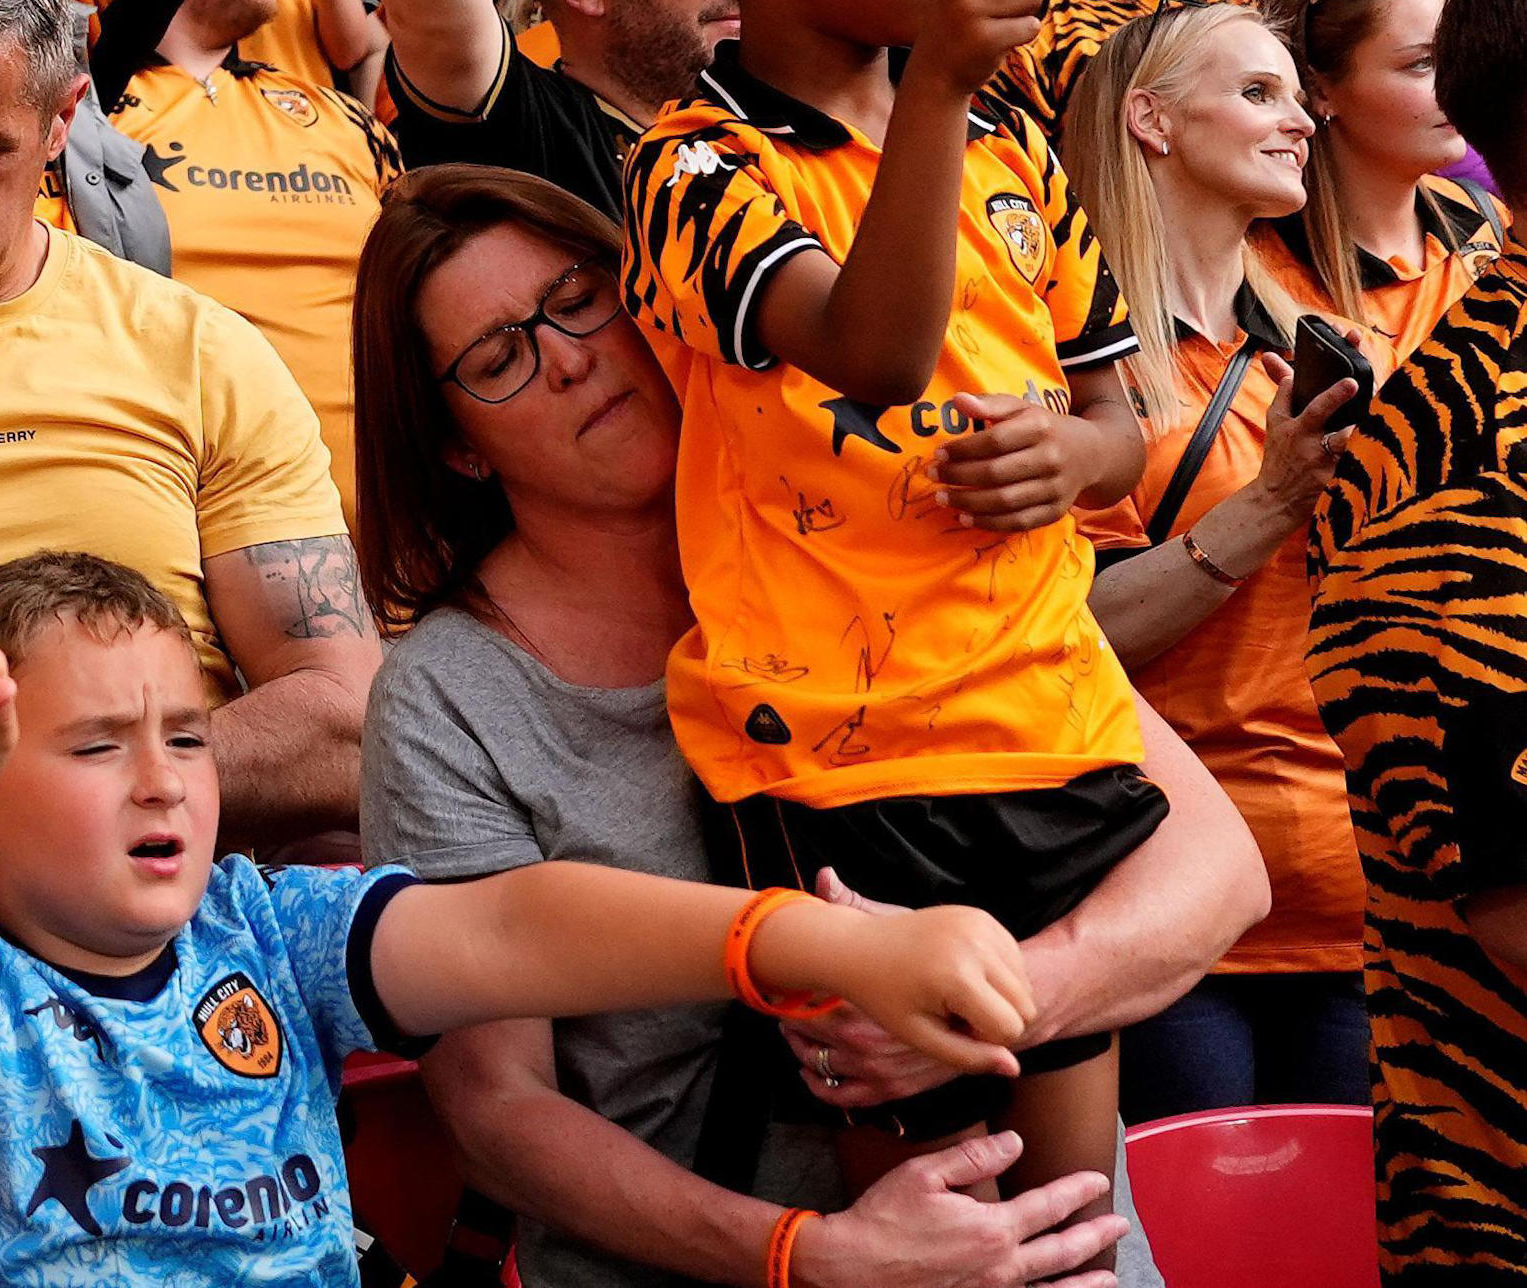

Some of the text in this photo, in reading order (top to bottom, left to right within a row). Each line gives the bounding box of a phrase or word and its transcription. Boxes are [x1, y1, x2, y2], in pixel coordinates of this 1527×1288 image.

[186, 163, 353, 195] corendon
[197, 978, 241, 1023] HULL CITY
[121, 1152, 322, 1229] coreno
